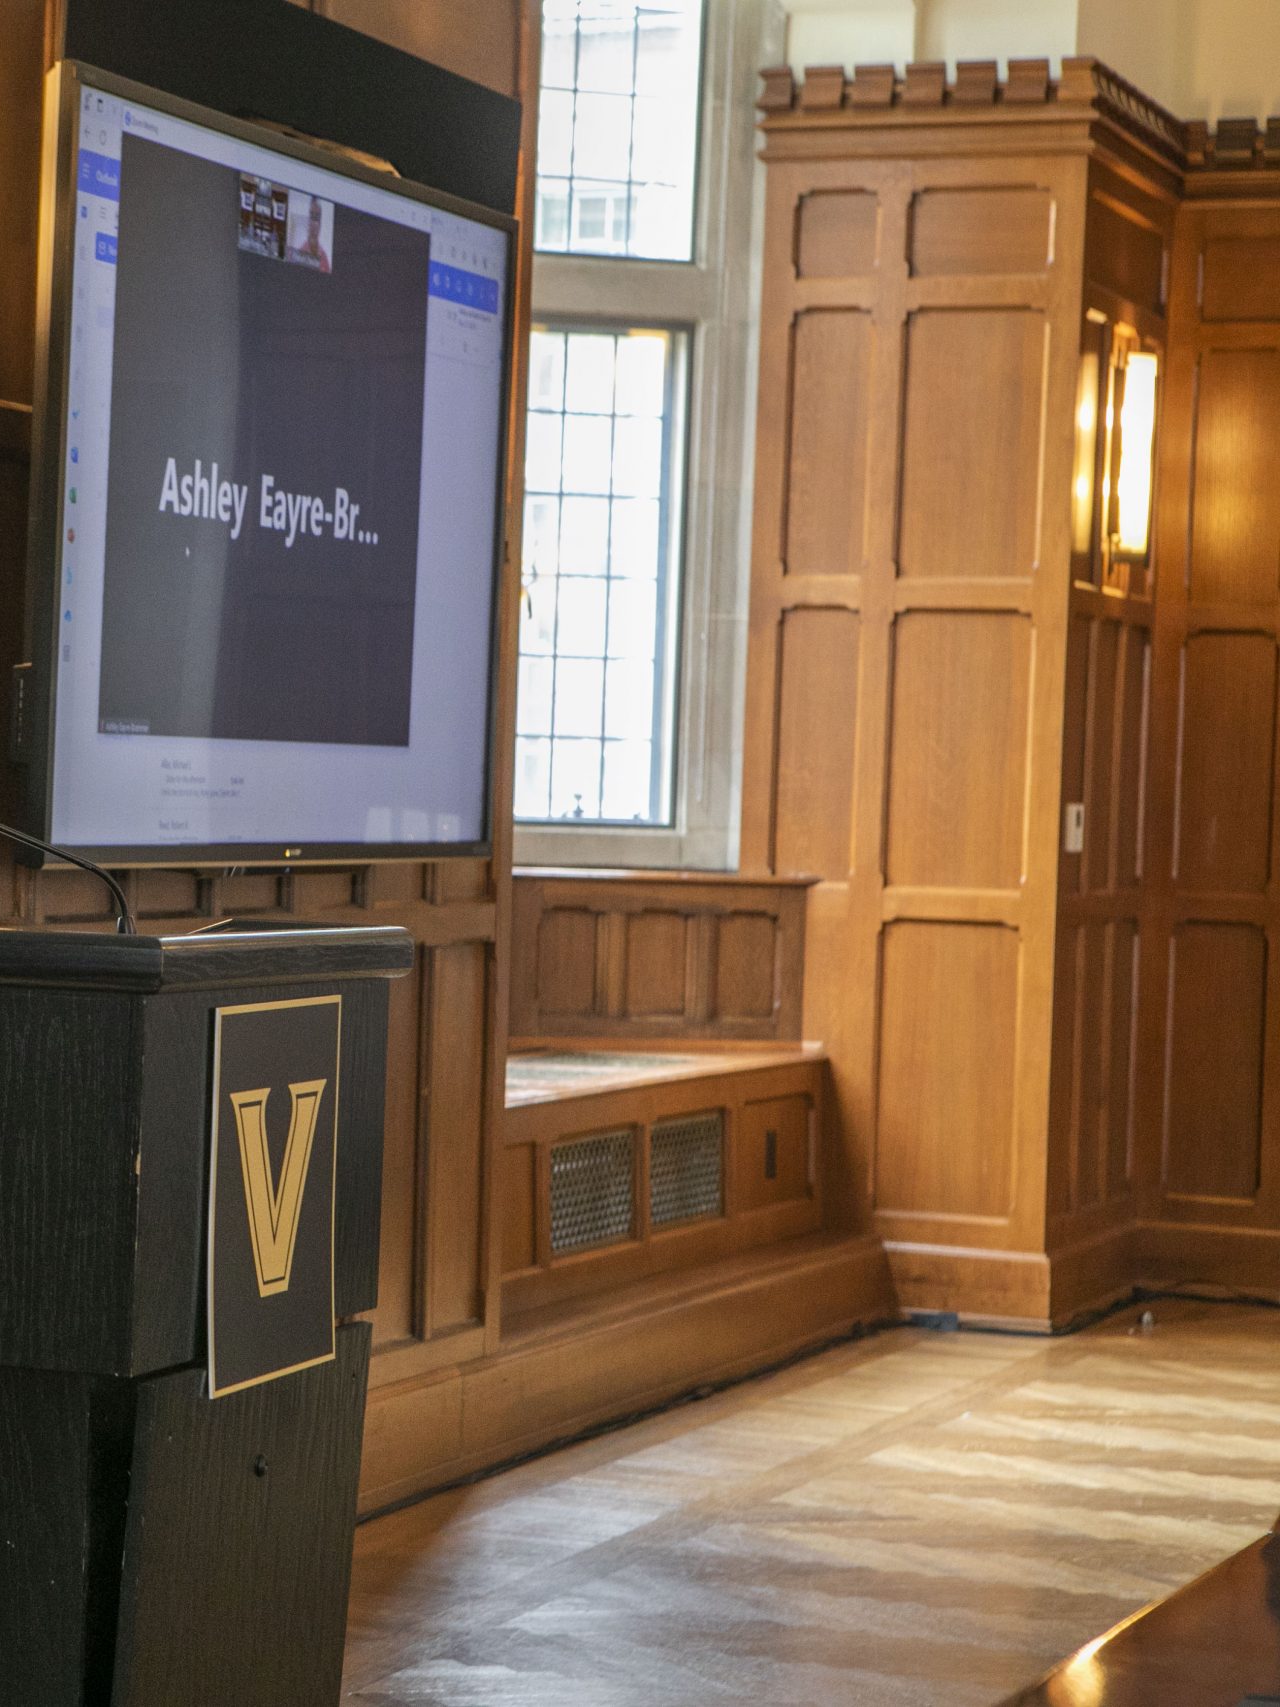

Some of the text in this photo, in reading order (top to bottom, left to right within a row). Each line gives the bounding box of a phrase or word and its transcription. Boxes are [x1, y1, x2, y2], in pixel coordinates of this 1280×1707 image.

[158, 457, 379, 548] Ashley Eayre-Br...
[229, 1078, 327, 1298] V
